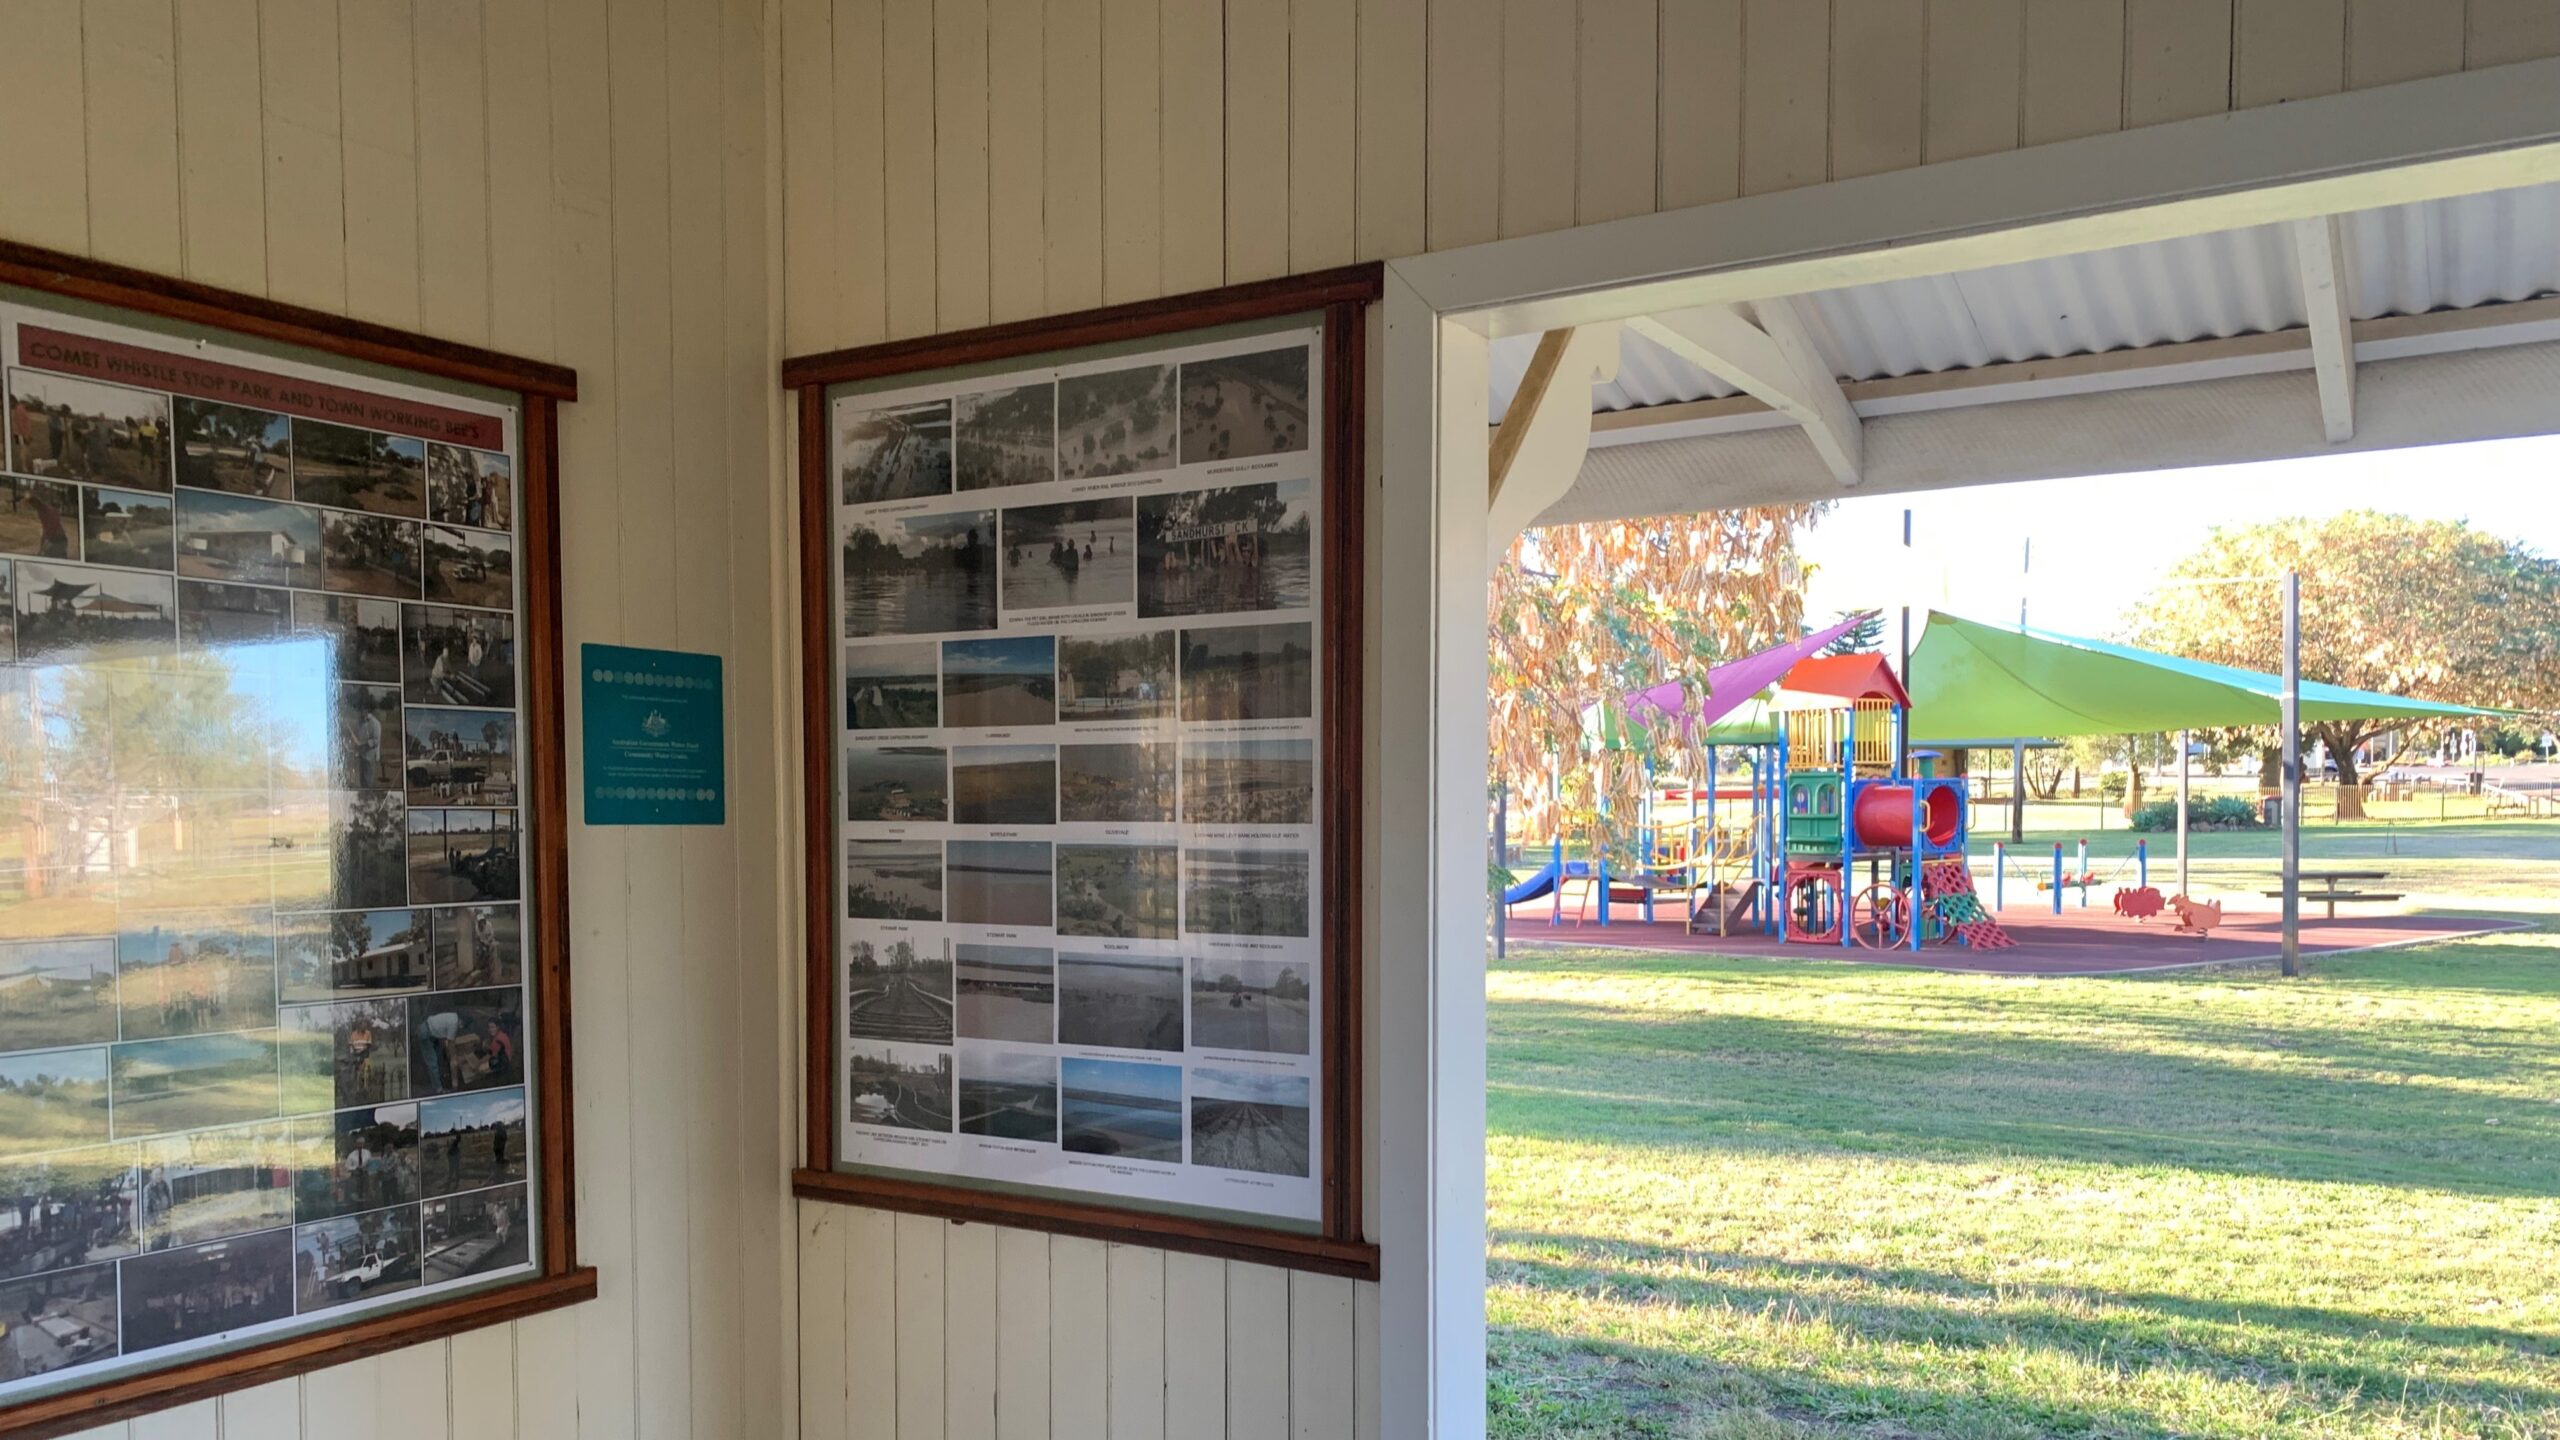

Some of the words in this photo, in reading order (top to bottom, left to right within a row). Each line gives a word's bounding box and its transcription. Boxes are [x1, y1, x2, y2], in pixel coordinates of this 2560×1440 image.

[30, 342, 100, 369] COMET
[106, 355, 177, 383] WHISTLE
[183, 370, 225, 389] STOP
[231, 381, 272, 401] PARK
[278, 390, 314, 409] AND
[320, 396, 364, 418] TOWN
[369, 407, 441, 433] WORKING
[1171, 524, 1226, 541] SANDHURST
[1234, 521, 1249, 533] CK
